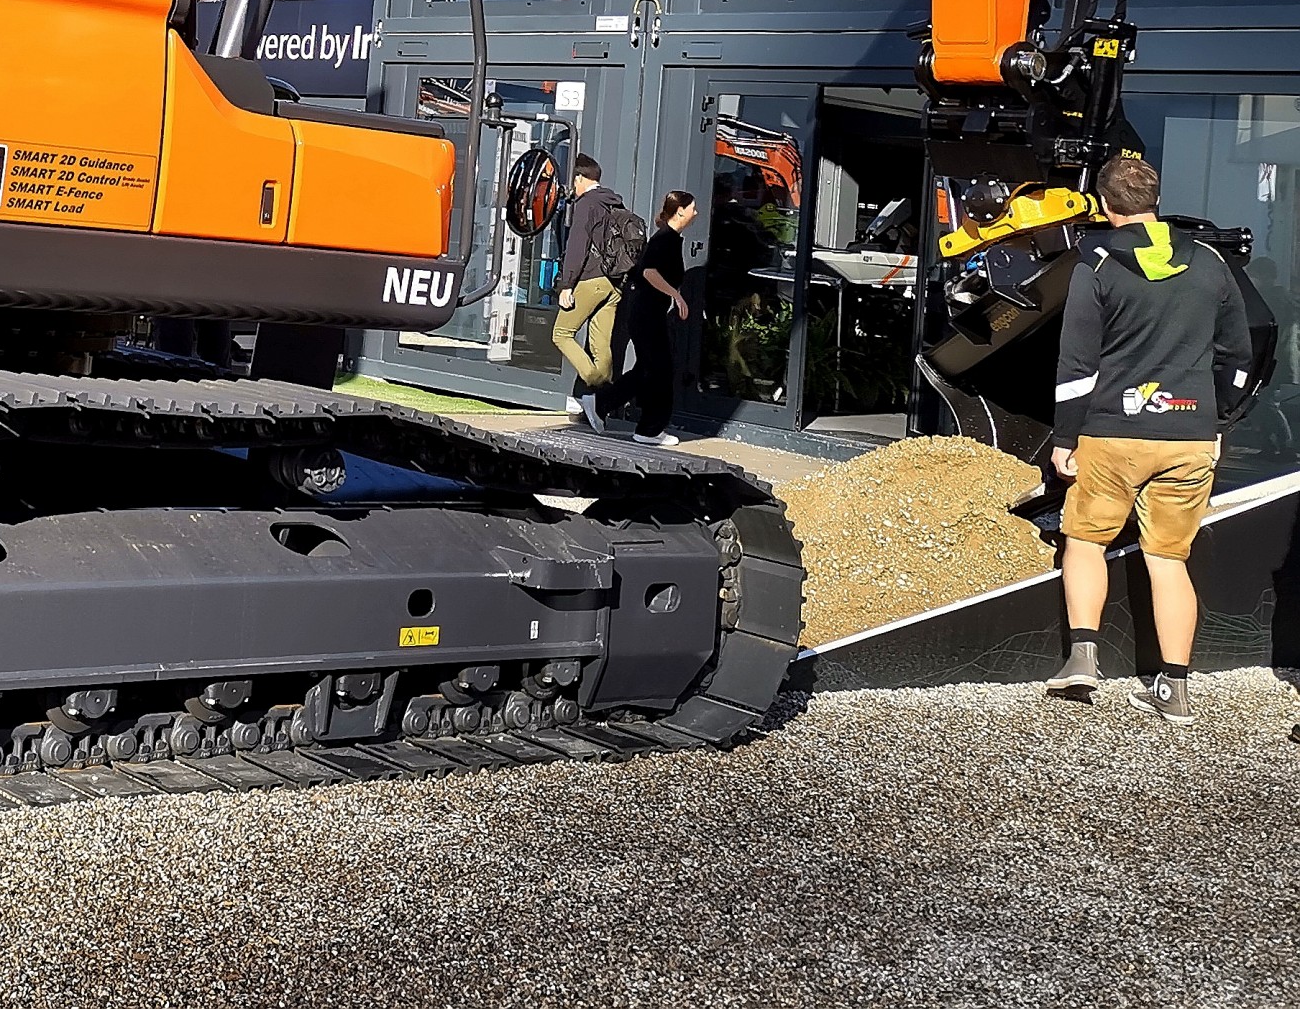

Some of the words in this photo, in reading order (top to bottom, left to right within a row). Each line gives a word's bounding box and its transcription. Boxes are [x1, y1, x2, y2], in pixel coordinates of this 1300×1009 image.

[319, 24, 351, 69] by
[561, 89, 580, 107] S3
[12, 149, 58, 164] SMART
[59, 154, 77, 166] 2D
[79, 156, 134, 172] Guidance
[10, 165, 56, 180] SMART
[57, 170, 75, 181] 2D
[77, 171, 121, 186] Control
[8, 182, 53, 196] SMART
[55, 185, 103, 201] E-Fence
[6, 197, 52, 211] SMART
[53, 199, 85, 214] Load
[382, 266, 455, 308] NEU
